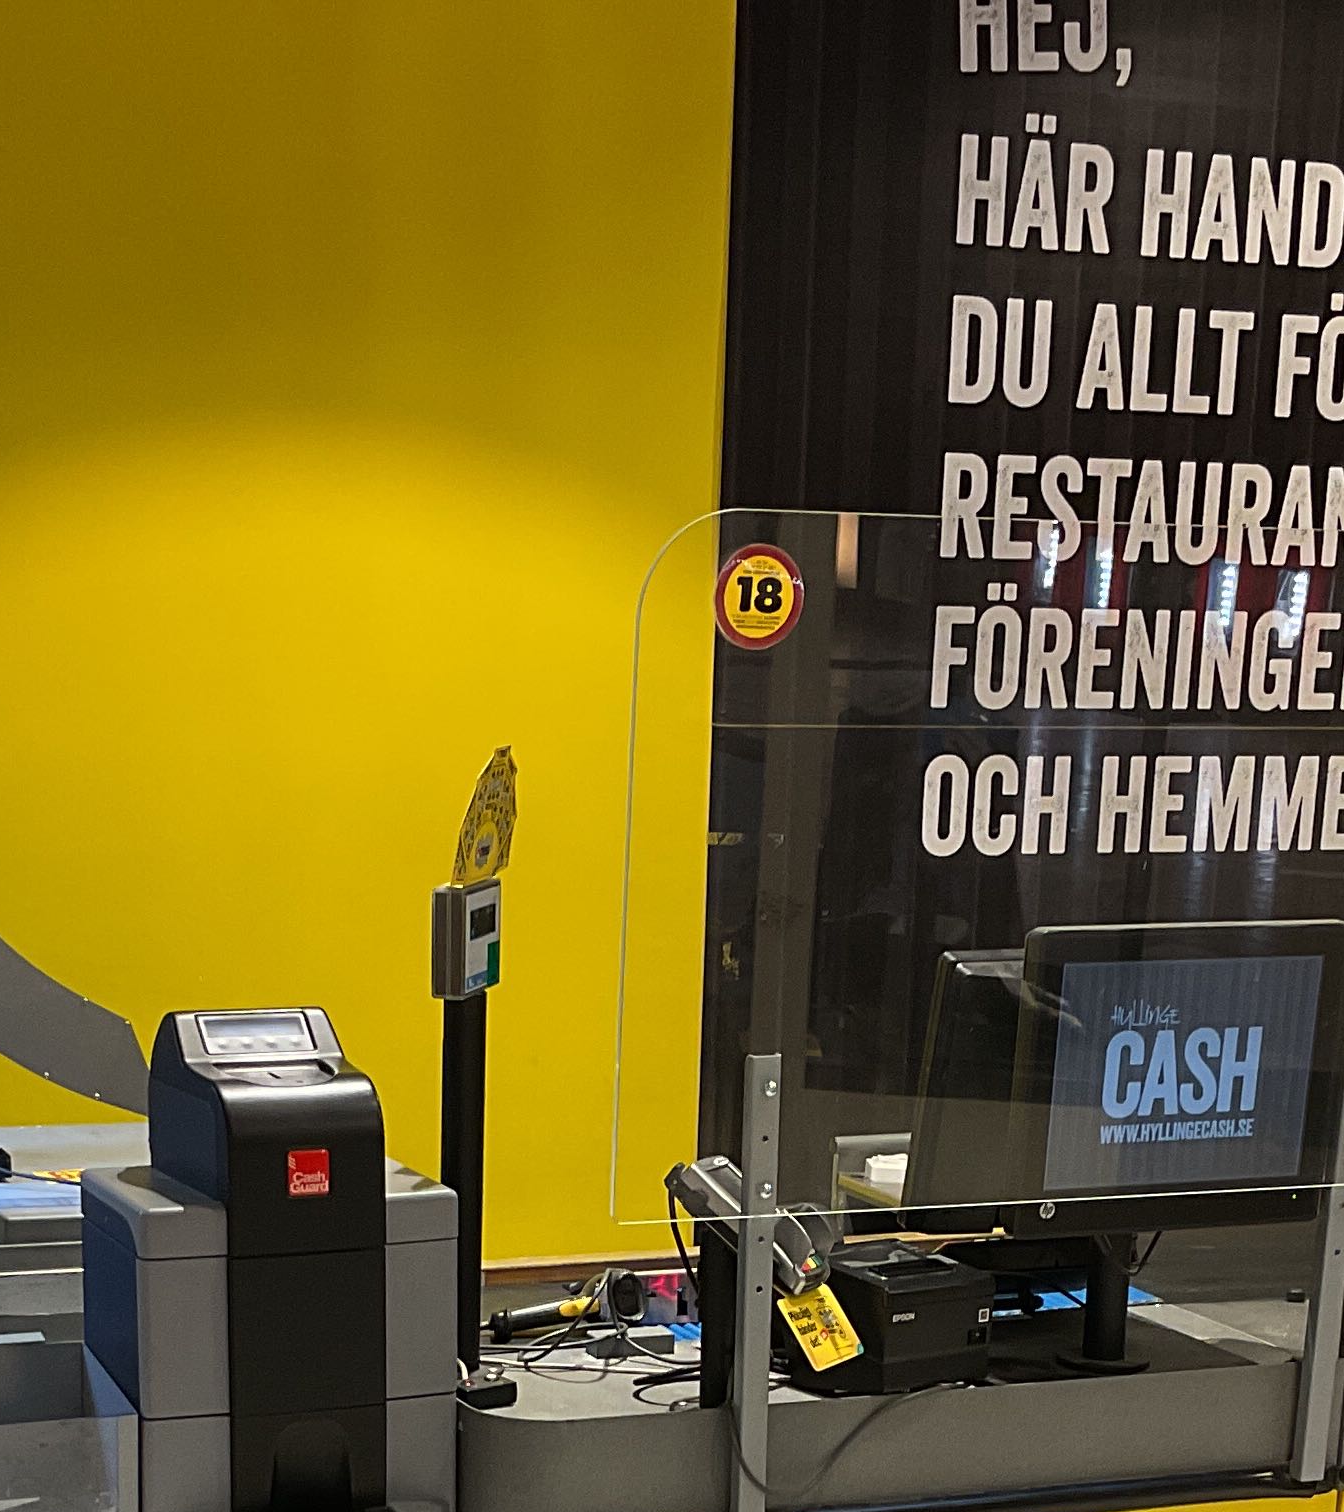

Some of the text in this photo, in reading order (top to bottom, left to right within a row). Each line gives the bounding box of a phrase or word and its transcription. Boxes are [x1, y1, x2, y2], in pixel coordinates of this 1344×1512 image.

[959, 0, 1132, 87] HEJ,
[956, 113, 1115, 254] HÄR
[946, 295, 1053, 408] DU
[1075, 303, 1255, 415] ALLT
[737, 576, 783, 614] 18
[920, 755, 1072, 857] OCH
[1110, 999, 1181, 1030] HYLLINGE
[1101, 1026, 1264, 1119] CASH
[1100, 1118, 1255, 1145] WWW.HYLLINGECASH.SE
[289, 1180, 329, 1193] Guard
[292, 1170, 326, 1183] Cash
[892, 1312, 916, 1323] EPSON
